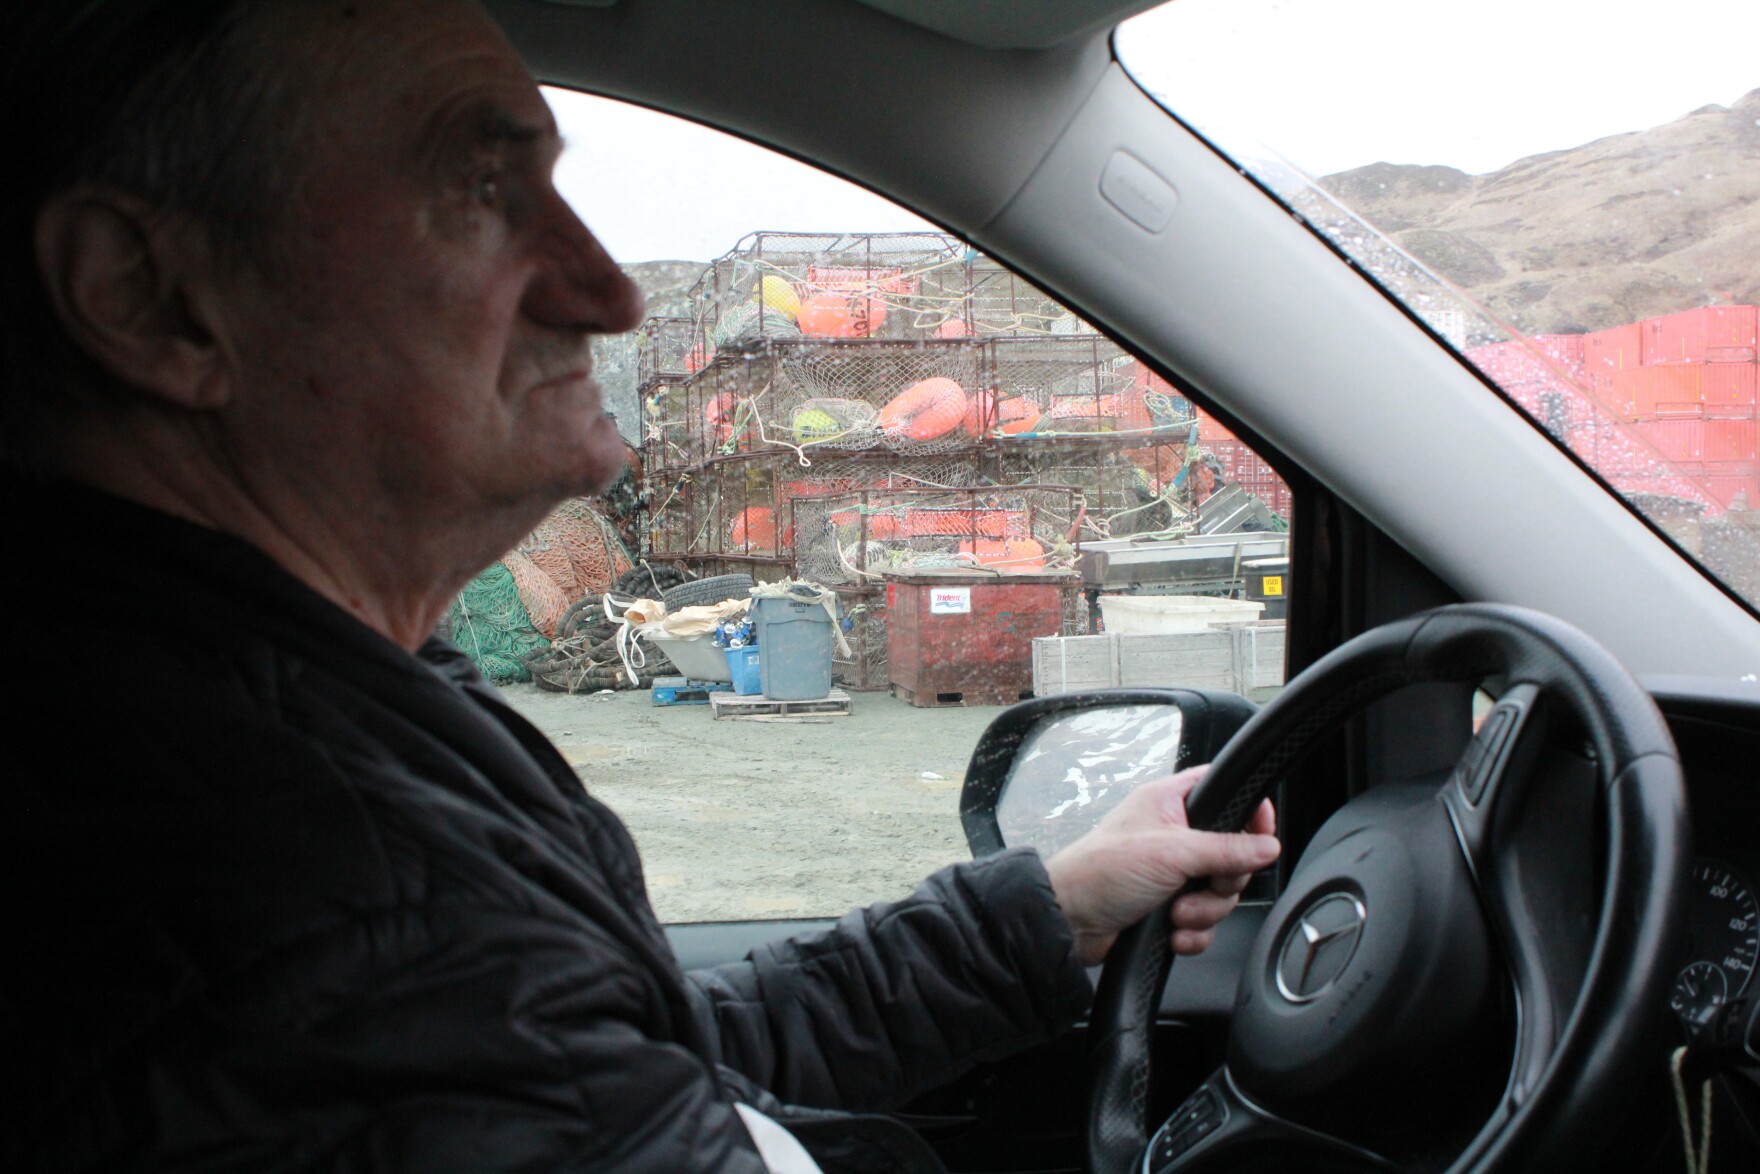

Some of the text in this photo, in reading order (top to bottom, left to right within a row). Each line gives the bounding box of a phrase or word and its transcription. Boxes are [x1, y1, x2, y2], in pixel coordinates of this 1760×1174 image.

[936, 594, 960, 602] Trident
[1710, 885, 1728, 898] 100
[1729, 918, 1747, 932] 120
